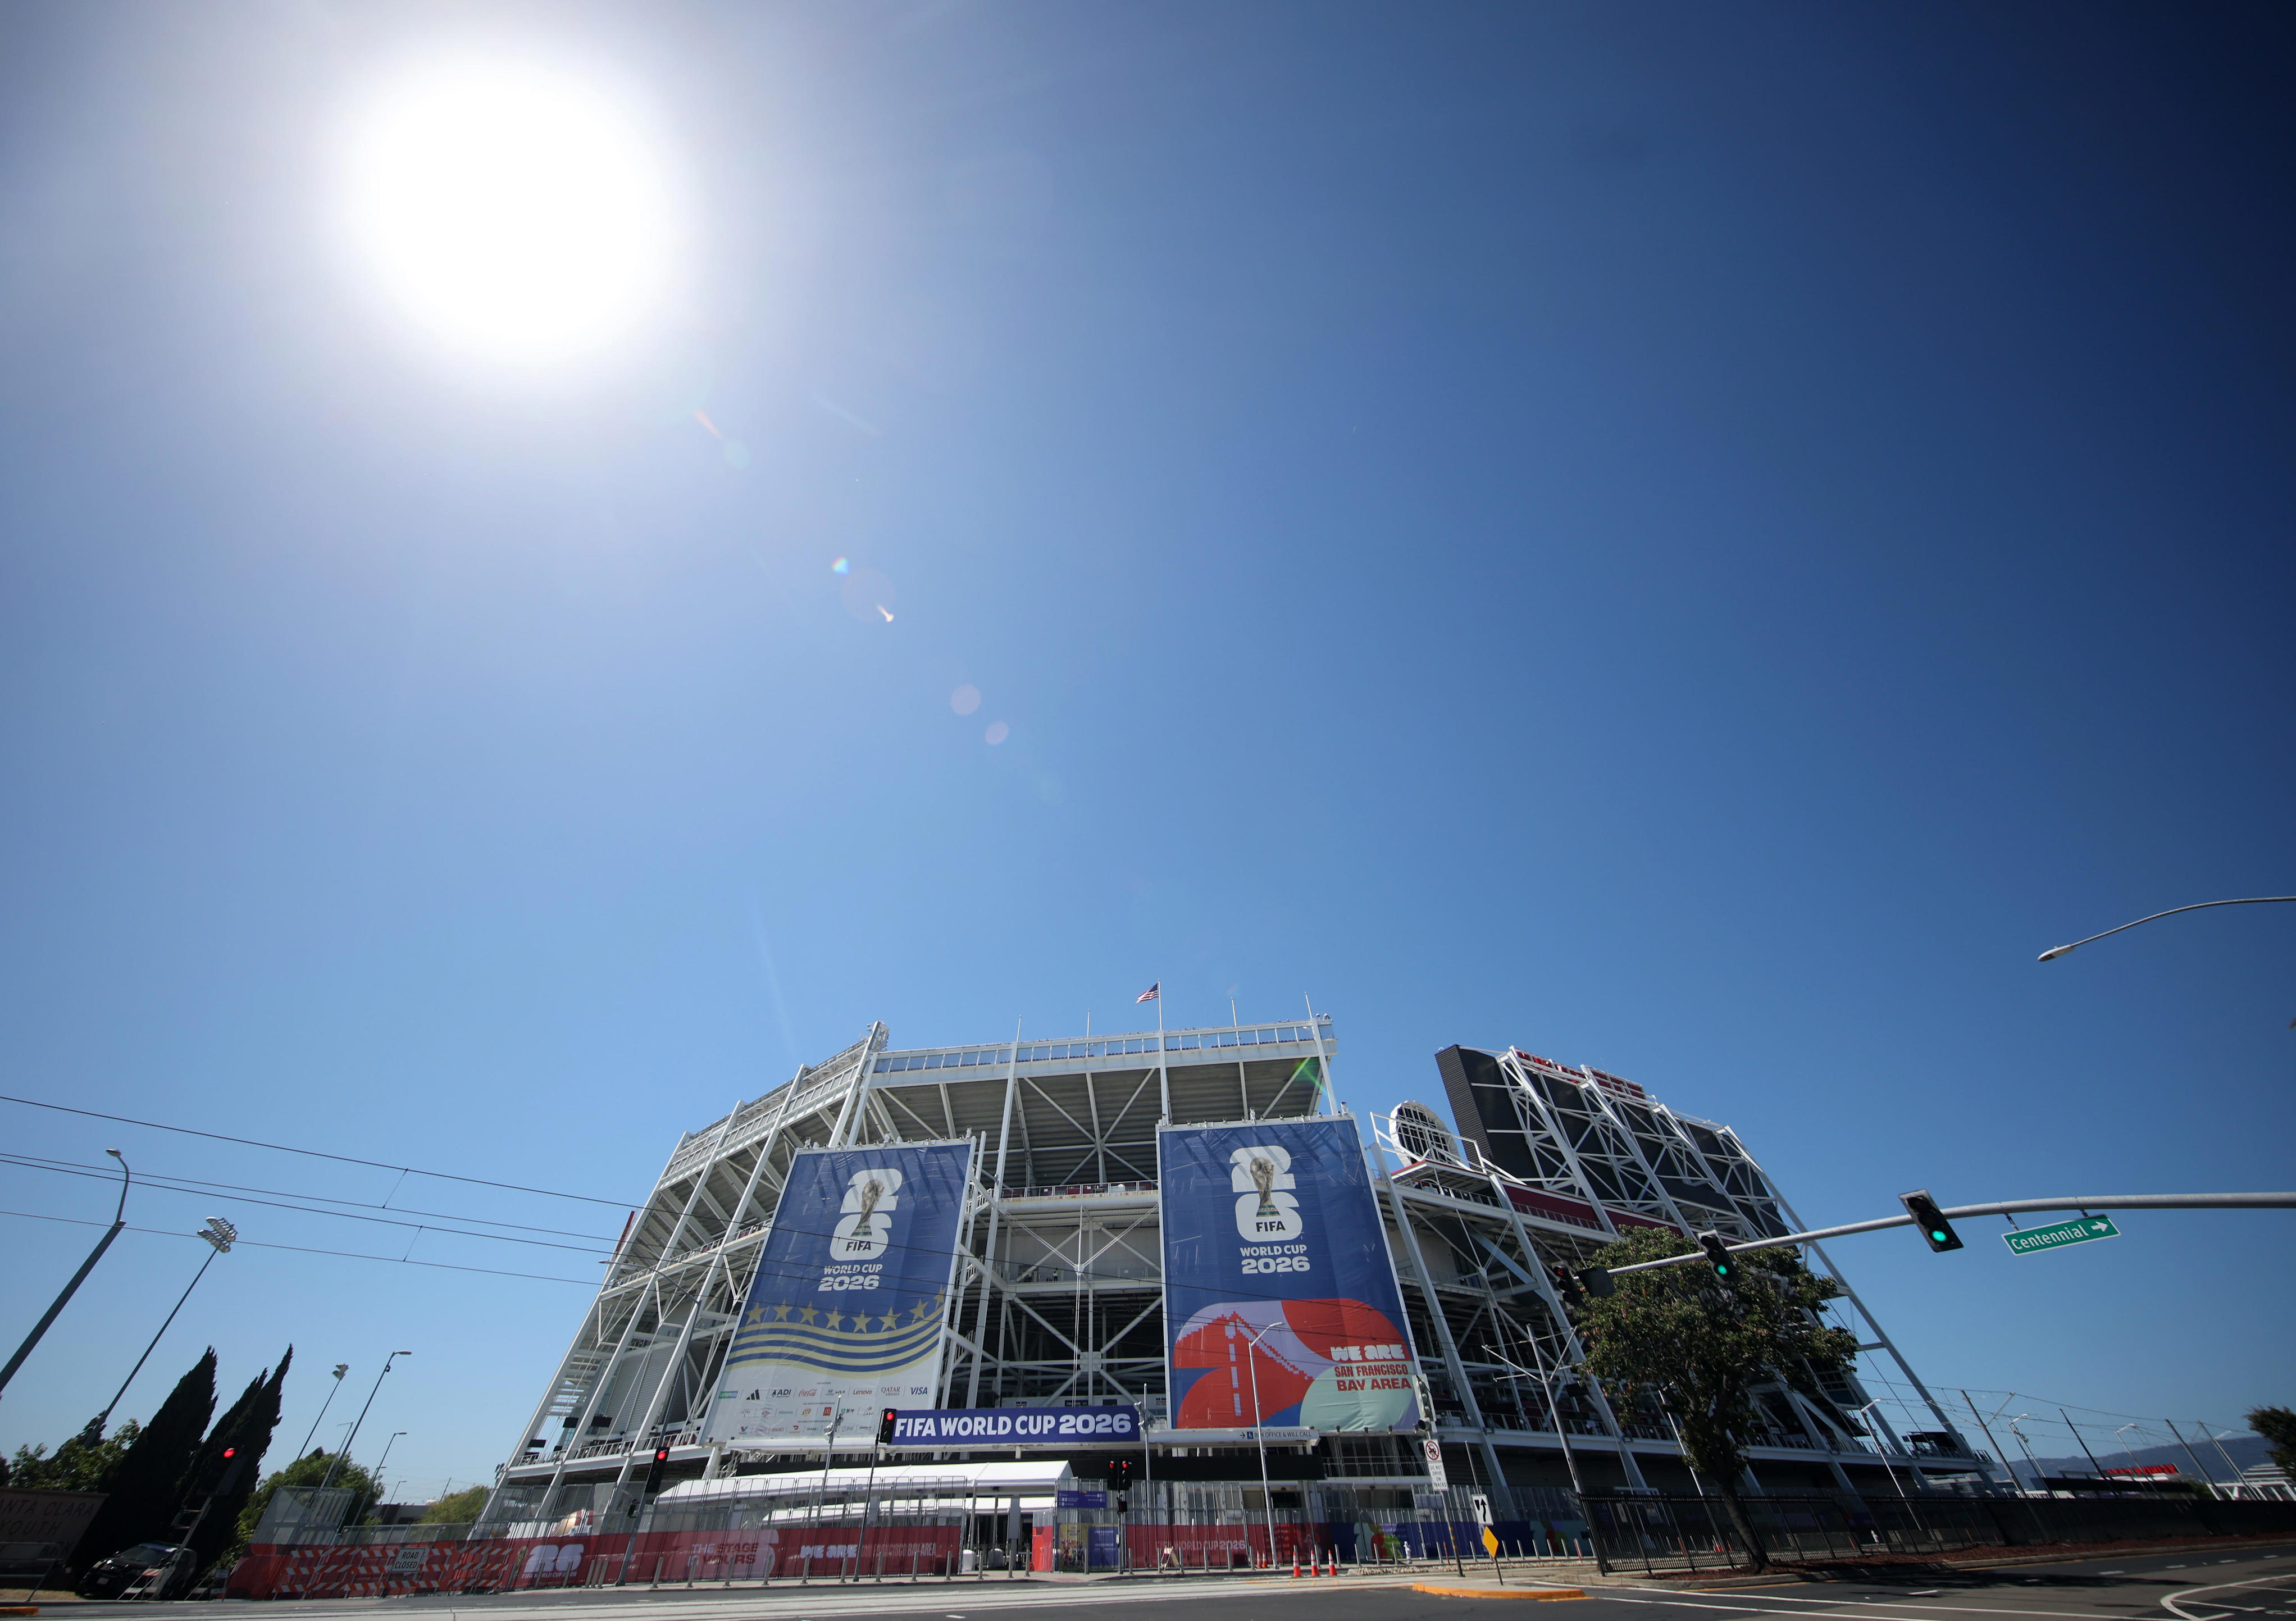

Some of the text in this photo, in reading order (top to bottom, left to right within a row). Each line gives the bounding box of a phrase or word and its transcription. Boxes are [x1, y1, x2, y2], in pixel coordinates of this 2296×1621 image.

[1256, 1221, 1286, 1232] FIFA
[2011, 1224, 2089, 1250] Centennial
[846, 1241, 872, 1251] FIFA
[1240, 1244, 1308, 1257] WORLD CUP
[824, 1264, 883, 1275] WORLD CUP
[1241, 1256, 1310, 1274] 2026
[818, 1275, 880, 1292] 2026
[1330, 1344, 1405, 1362] WE ARE
[1334, 1364, 1409, 1377] SAN FRANCISCO
[1337, 1377, 1412, 1391] BAY AREA
[910, 1387, 928, 1395] VISA
[894, 1413, 1131, 1438] FIFA WORLD CUP 2026
[43, 1501, 94, 1517] CLARA
[691, 1542, 759, 1554] THE STAGE
[921, 1542, 937, 1556] AREA
[1174, 1540, 1202, 1550] WORLD
[1204, 1540, 1219, 1550] CUP
[1219, 1540, 1246, 1550] 2026
